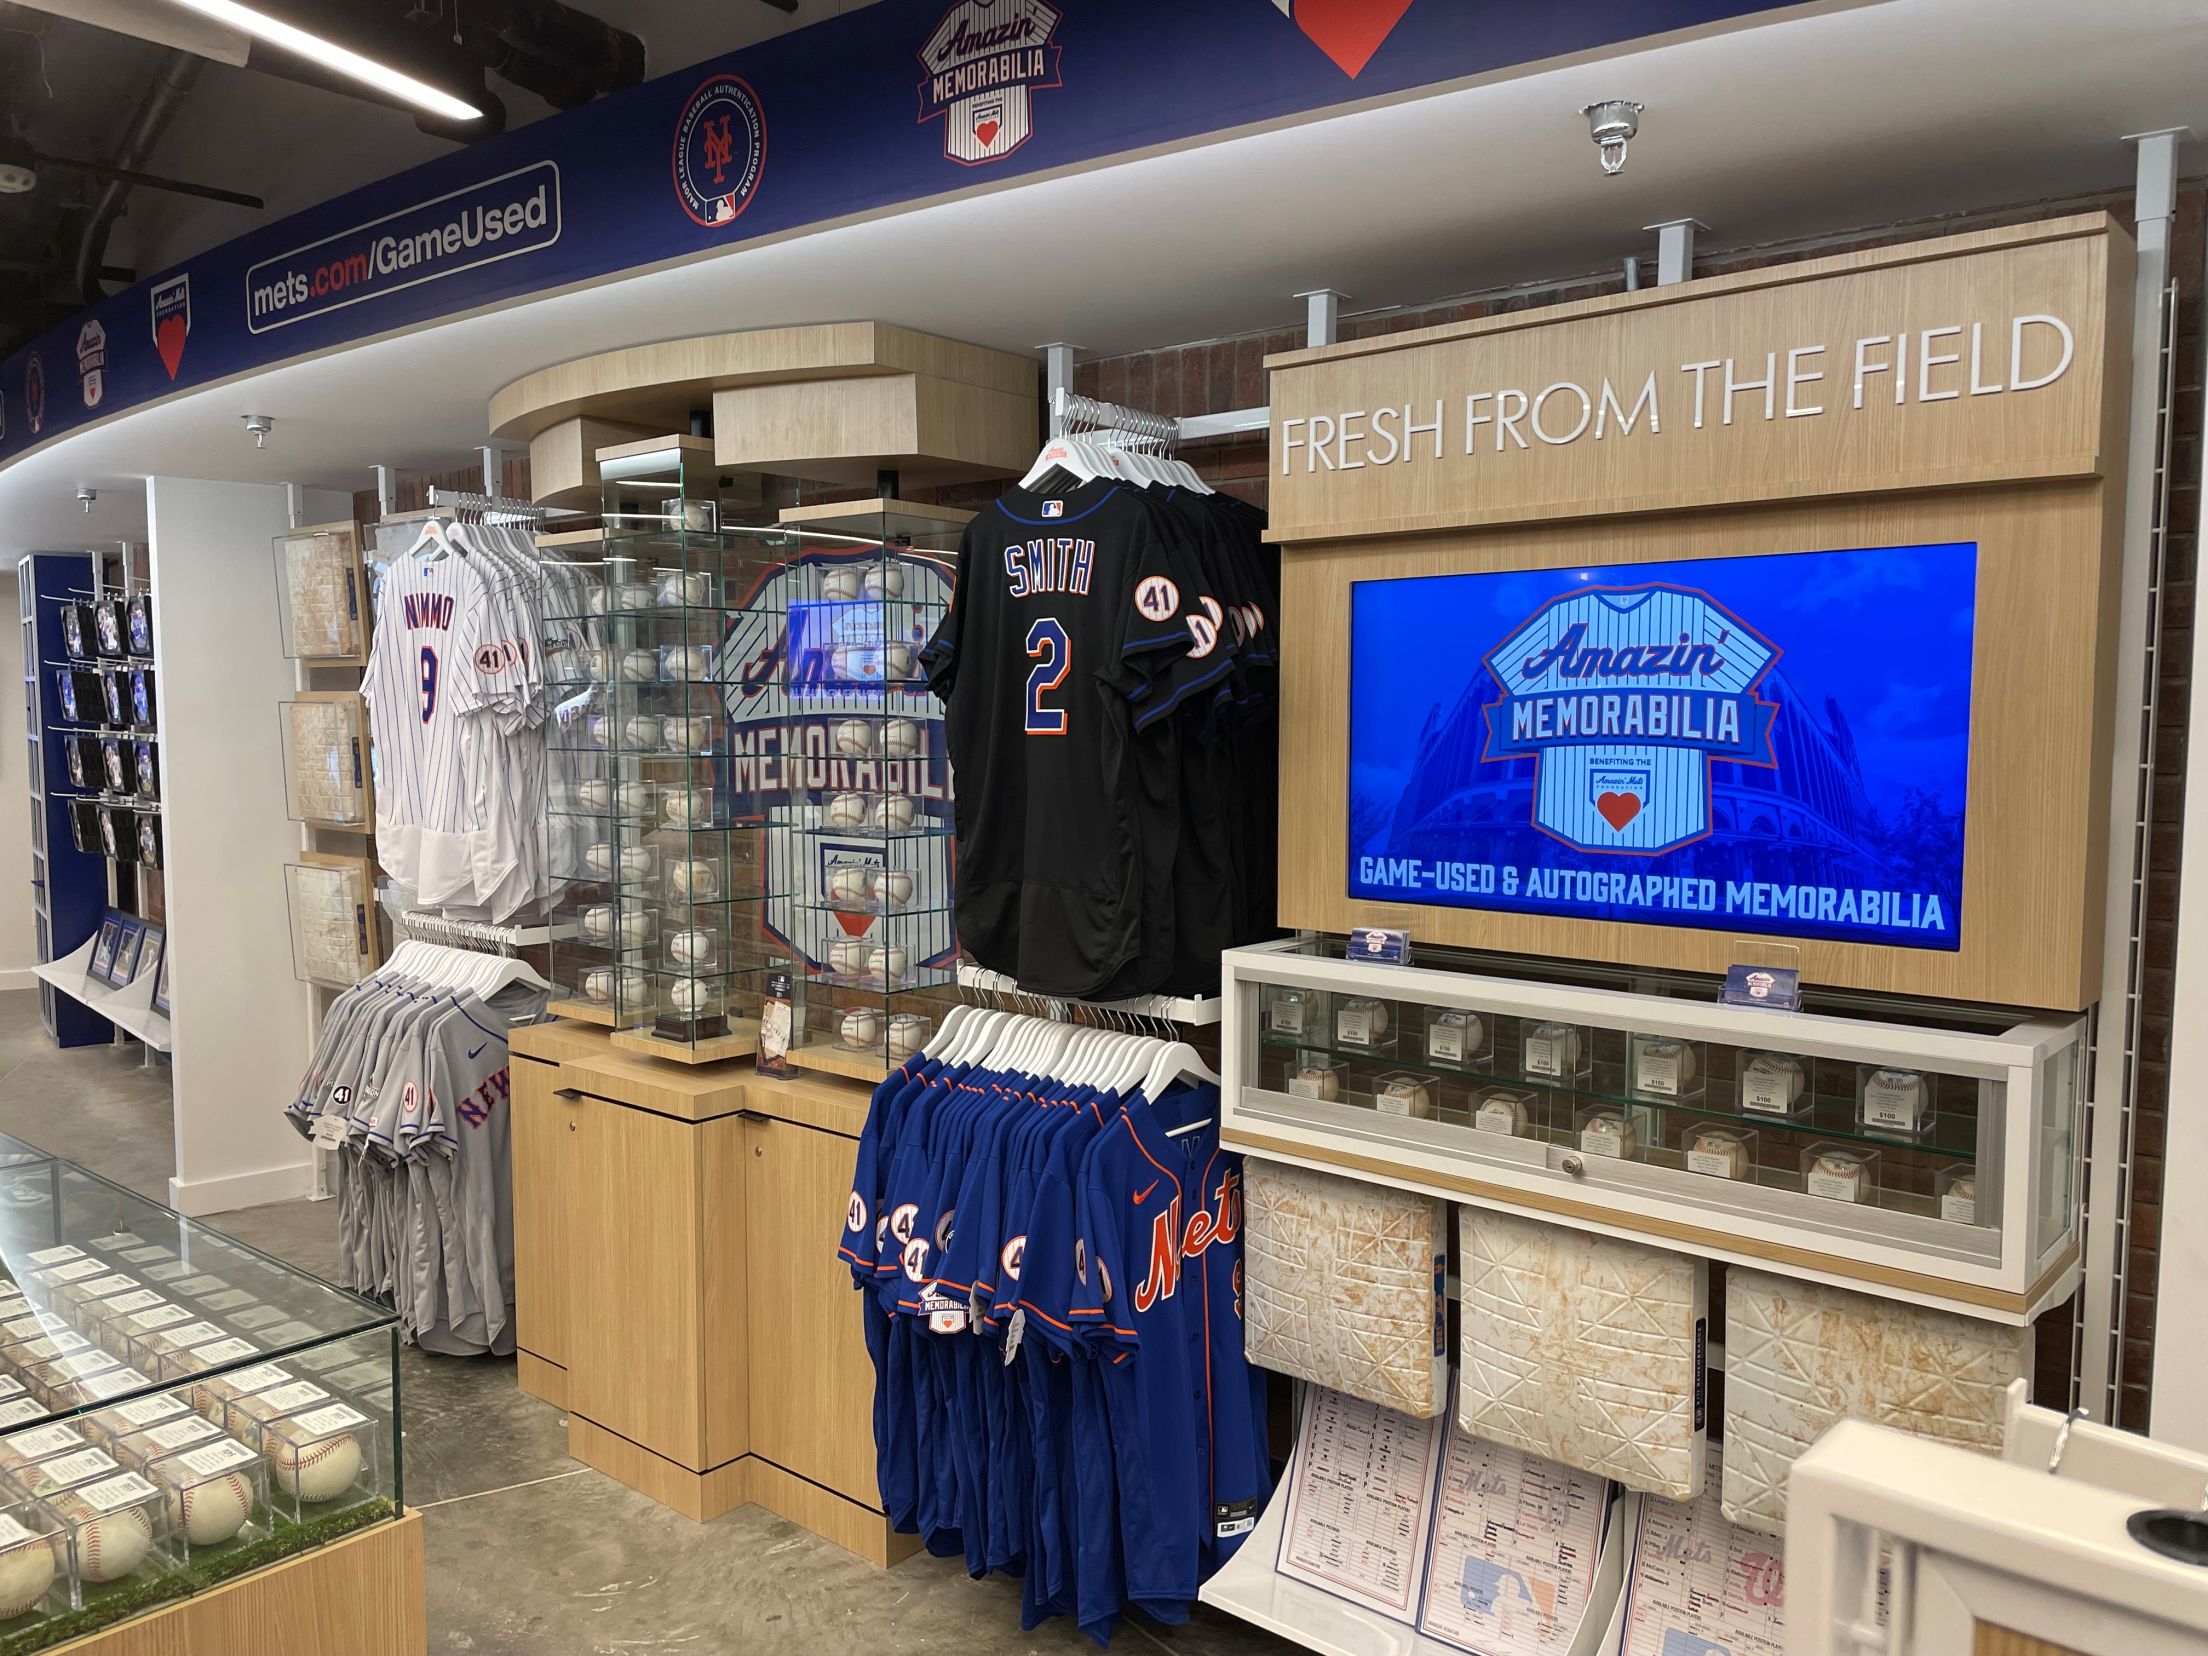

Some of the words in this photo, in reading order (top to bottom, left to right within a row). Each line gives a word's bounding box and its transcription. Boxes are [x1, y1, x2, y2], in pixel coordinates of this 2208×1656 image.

[933, 49, 1044, 104] MEMORABILIA
[682, 88, 713, 133] BASEBALL
[714, 84, 760, 139] AUTHENTICATION
[678, 137, 687, 180] LEAGUE
[740, 142, 760, 197] PROGRAM
[682, 180, 699, 210] MAJOR
[253, 184, 548, 317] mets.com/GameUsed
[1282, 397, 1446, 476] FRESH
[1464, 368, 1661, 456] FROM
[1680, 345, 1827, 428] THE
[1853, 313, 2076, 410] FIELD
[1004, 538, 1096, 599] SMITH
[404, 592, 454, 631] NIMMO
[1143, 584, 1172, 612] 41
[479, 650, 499, 668] 41
[1521, 622, 1730, 681] Amazin'
[421, 646, 438, 724] 9
[1025, 616, 1072, 735] 2
[1511, 694, 1742, 744] MEMORABILIA
[1590, 758, 1634, 766] BENEFITING
[1635, 758, 1652, 766] THE
[1359, 855, 1495, 896] GAME-USED
[1502, 865, 1520, 897] &
[1526, 869, 1716, 913] AUTOGRAPHED
[1725, 881, 1946, 931] MEMORABILIA
[334, 1088, 350, 1102] 41
[405, 1087, 414, 1106] 41
[1756, 1095, 1772, 1103] $100
[1879, 1112, 1896, 1120] $100
[850, 1199, 861, 1226] 41
